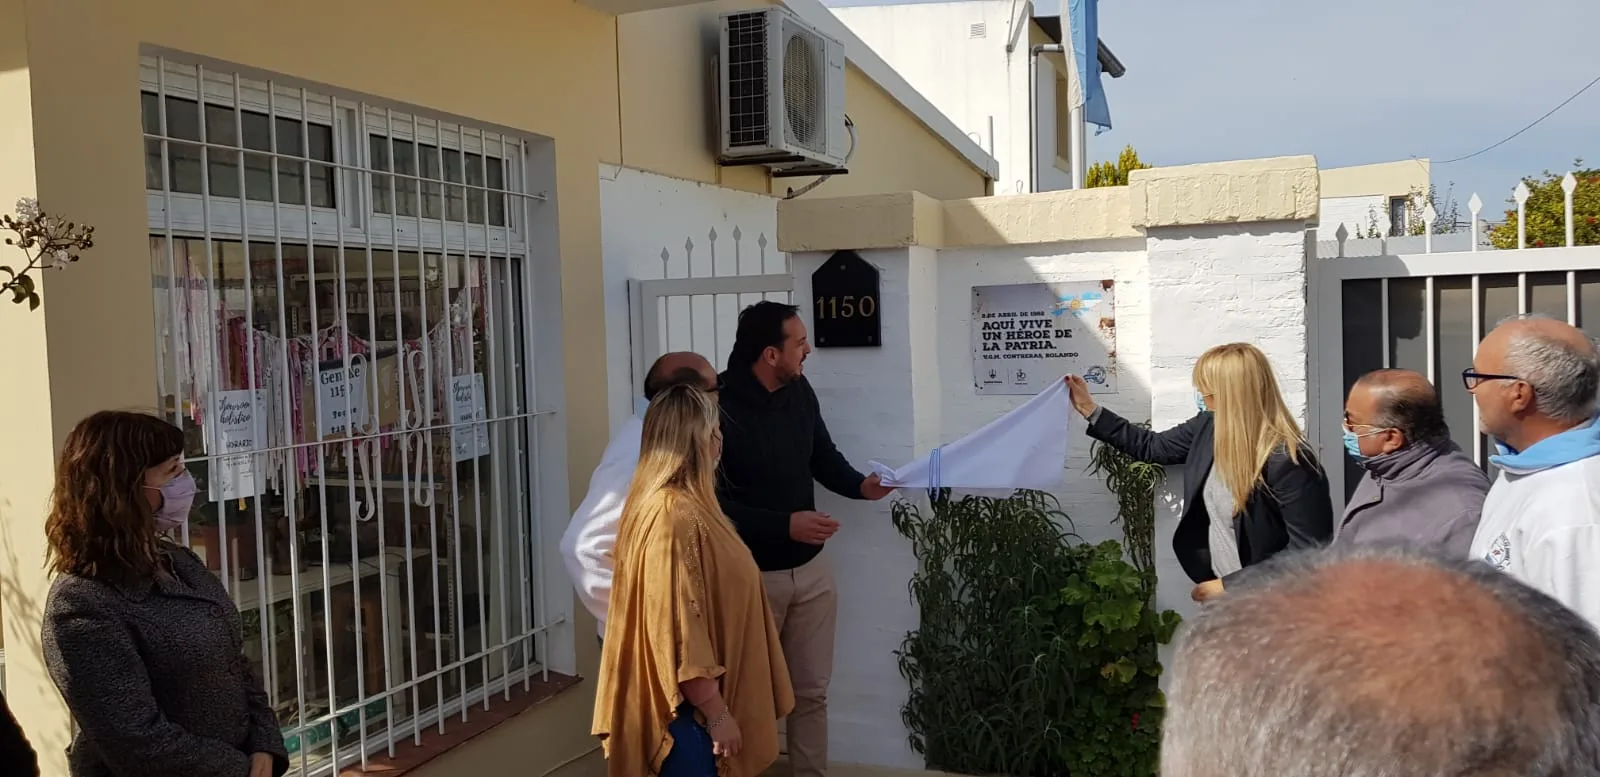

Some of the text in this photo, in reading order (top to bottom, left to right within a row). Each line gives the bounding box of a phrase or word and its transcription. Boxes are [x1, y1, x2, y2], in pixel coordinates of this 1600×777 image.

[816, 295, 875, 319] 1150
[982, 318, 1053, 331] AQUÍ VIVE
[982, 328, 1072, 341] UN HÉROE DE
[982, 340, 1057, 352] LA PATRIA.
